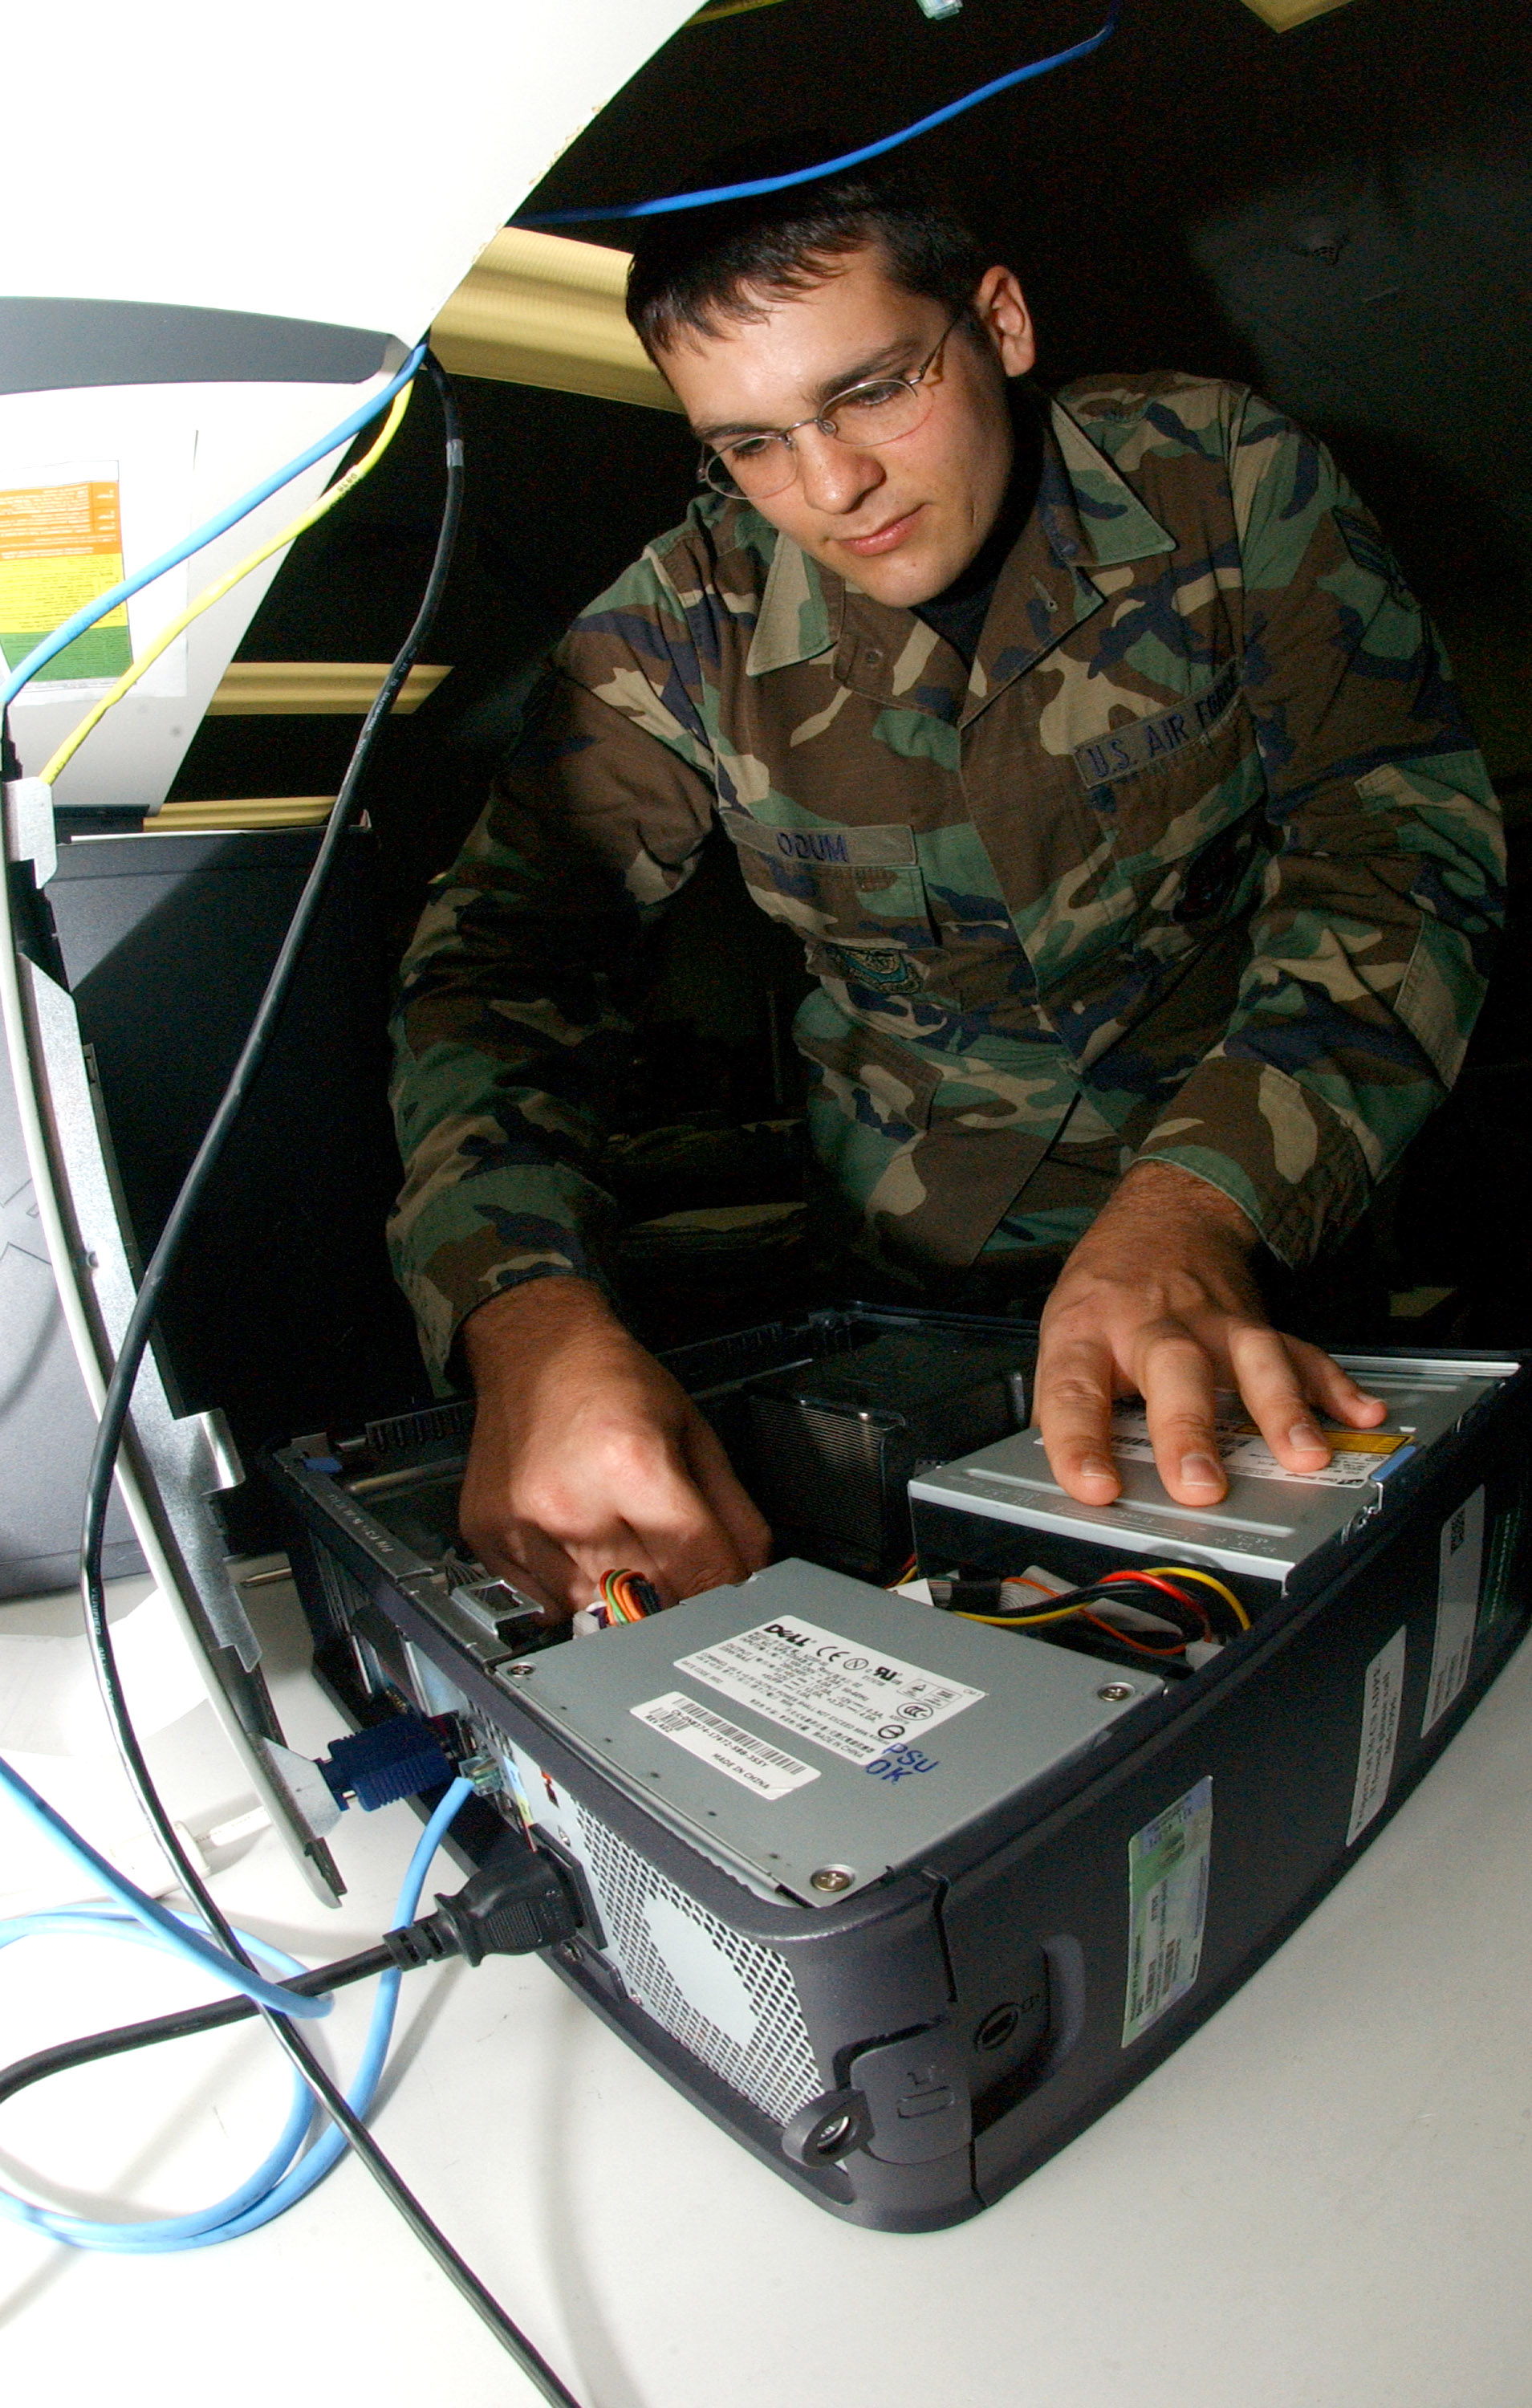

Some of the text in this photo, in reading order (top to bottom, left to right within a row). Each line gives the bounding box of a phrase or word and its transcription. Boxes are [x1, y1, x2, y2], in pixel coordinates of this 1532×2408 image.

[1086, 738, 1138, 778] U.S.
[1144, 713, 1190, 759] AIR
[775, 832, 851, 864] ODUM
[91, 1586, 103, 1636] VERIFIED
[763, 1623, 811, 1647] DELL
[812, 1731, 835, 1743] MADE
[839, 1744, 866, 1759] CHINA
[881, 1742, 941, 1773] PSU
[710, 1753, 771, 1789] MADE IN CHINA
[865, 1759, 913, 1786] OK
